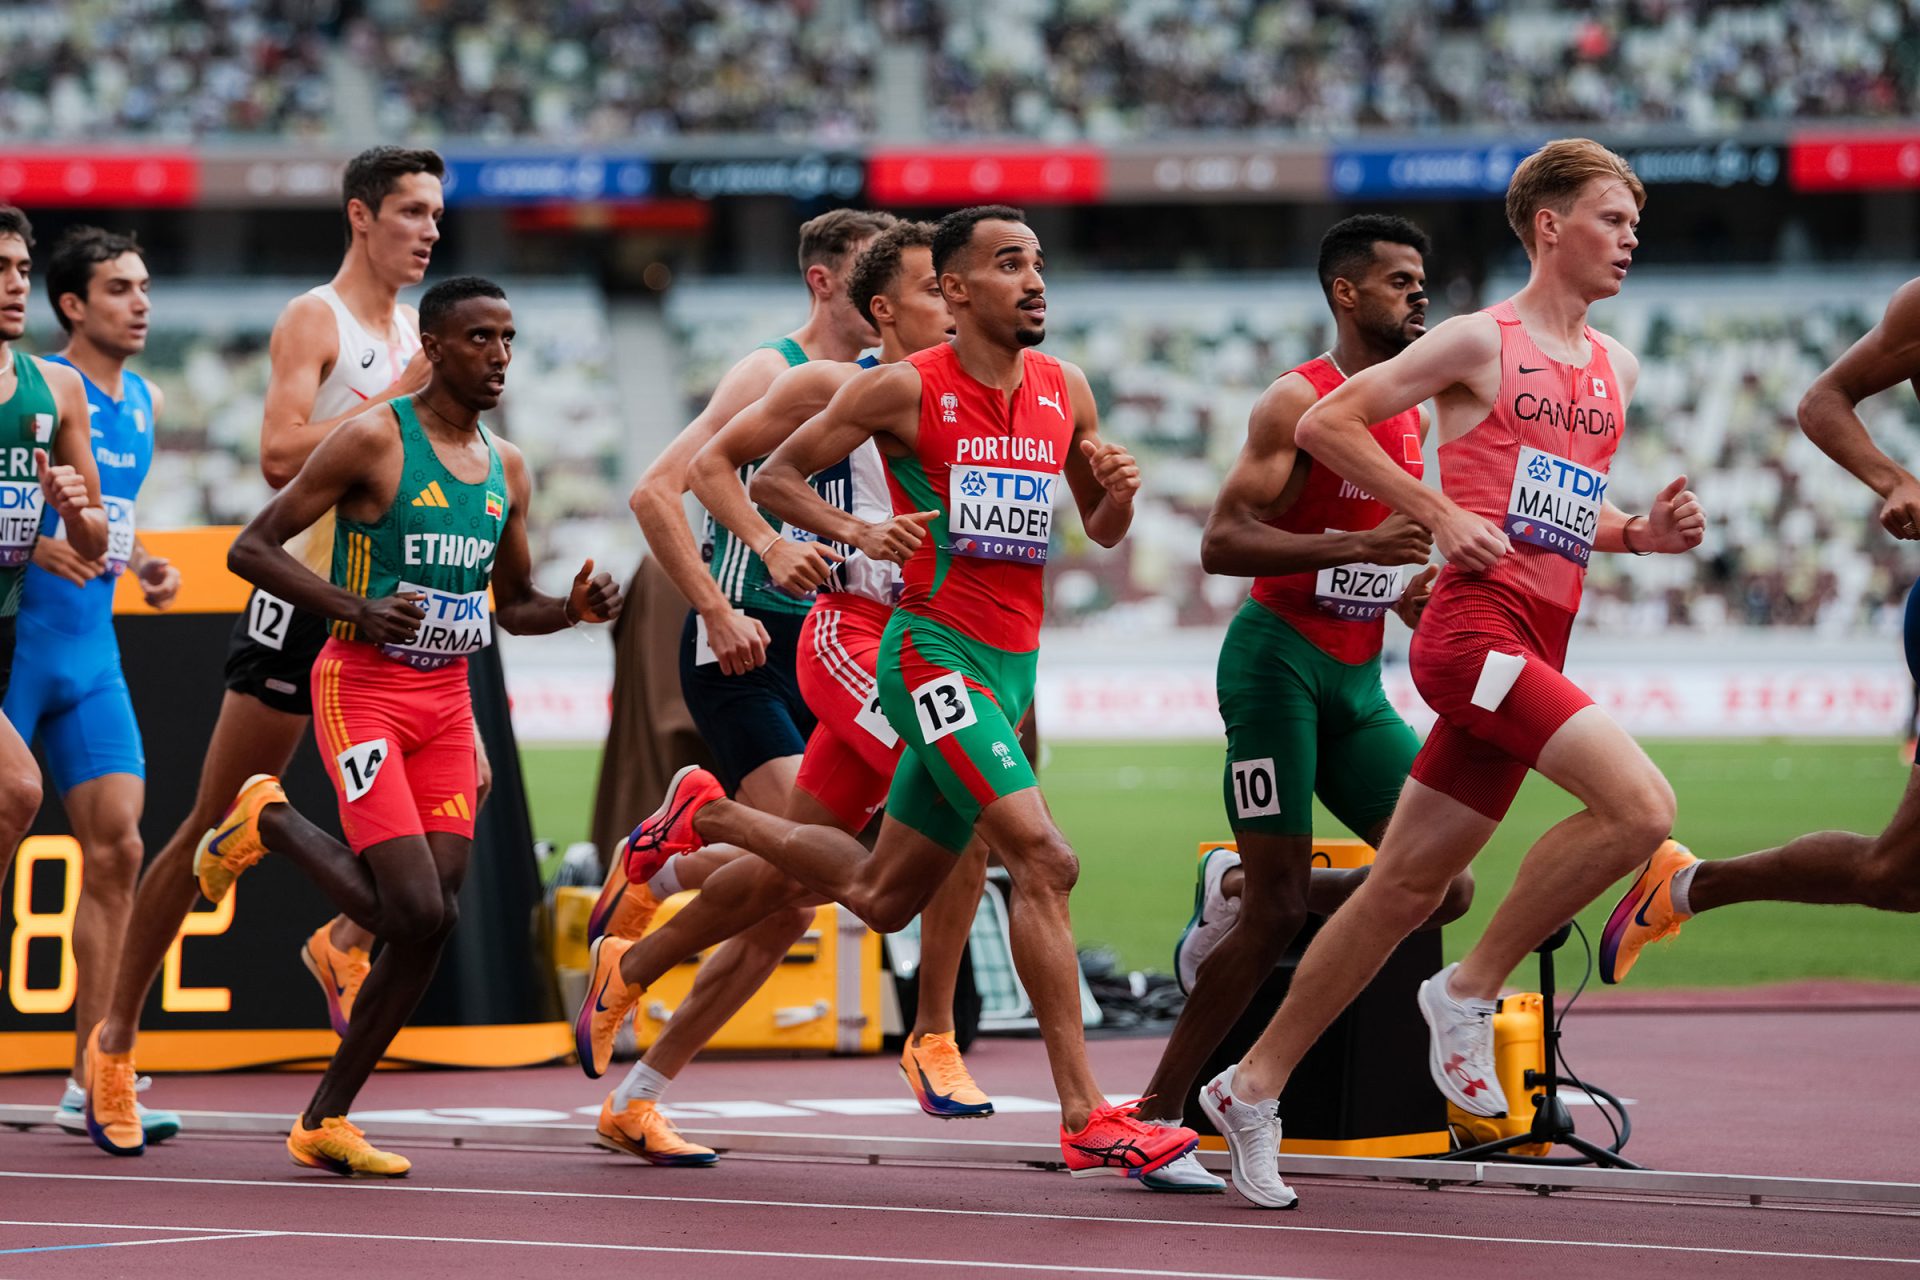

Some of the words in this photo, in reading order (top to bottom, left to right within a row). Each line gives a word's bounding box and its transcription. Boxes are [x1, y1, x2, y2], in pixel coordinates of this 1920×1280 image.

[943, 415, 958, 423] FPA
[1514, 392, 1617, 439] CANADA
[96, 447, 136, 468] ITALIA
[956, 436, 1057, 465] PORTUGAL
[0, 487, 38, 511] DK
[987, 472, 1052, 504] TDK
[1552, 459, 1609, 505] TDK
[959, 502, 1049, 538] NADER
[1330, 567, 1398, 599] RIZQY
[255, 597, 284, 641] 12
[432, 594, 484, 621] TDK
[919, 684, 966, 731] 13
[344, 748, 382, 791] 14
[1235, 767, 1272, 810] 10
